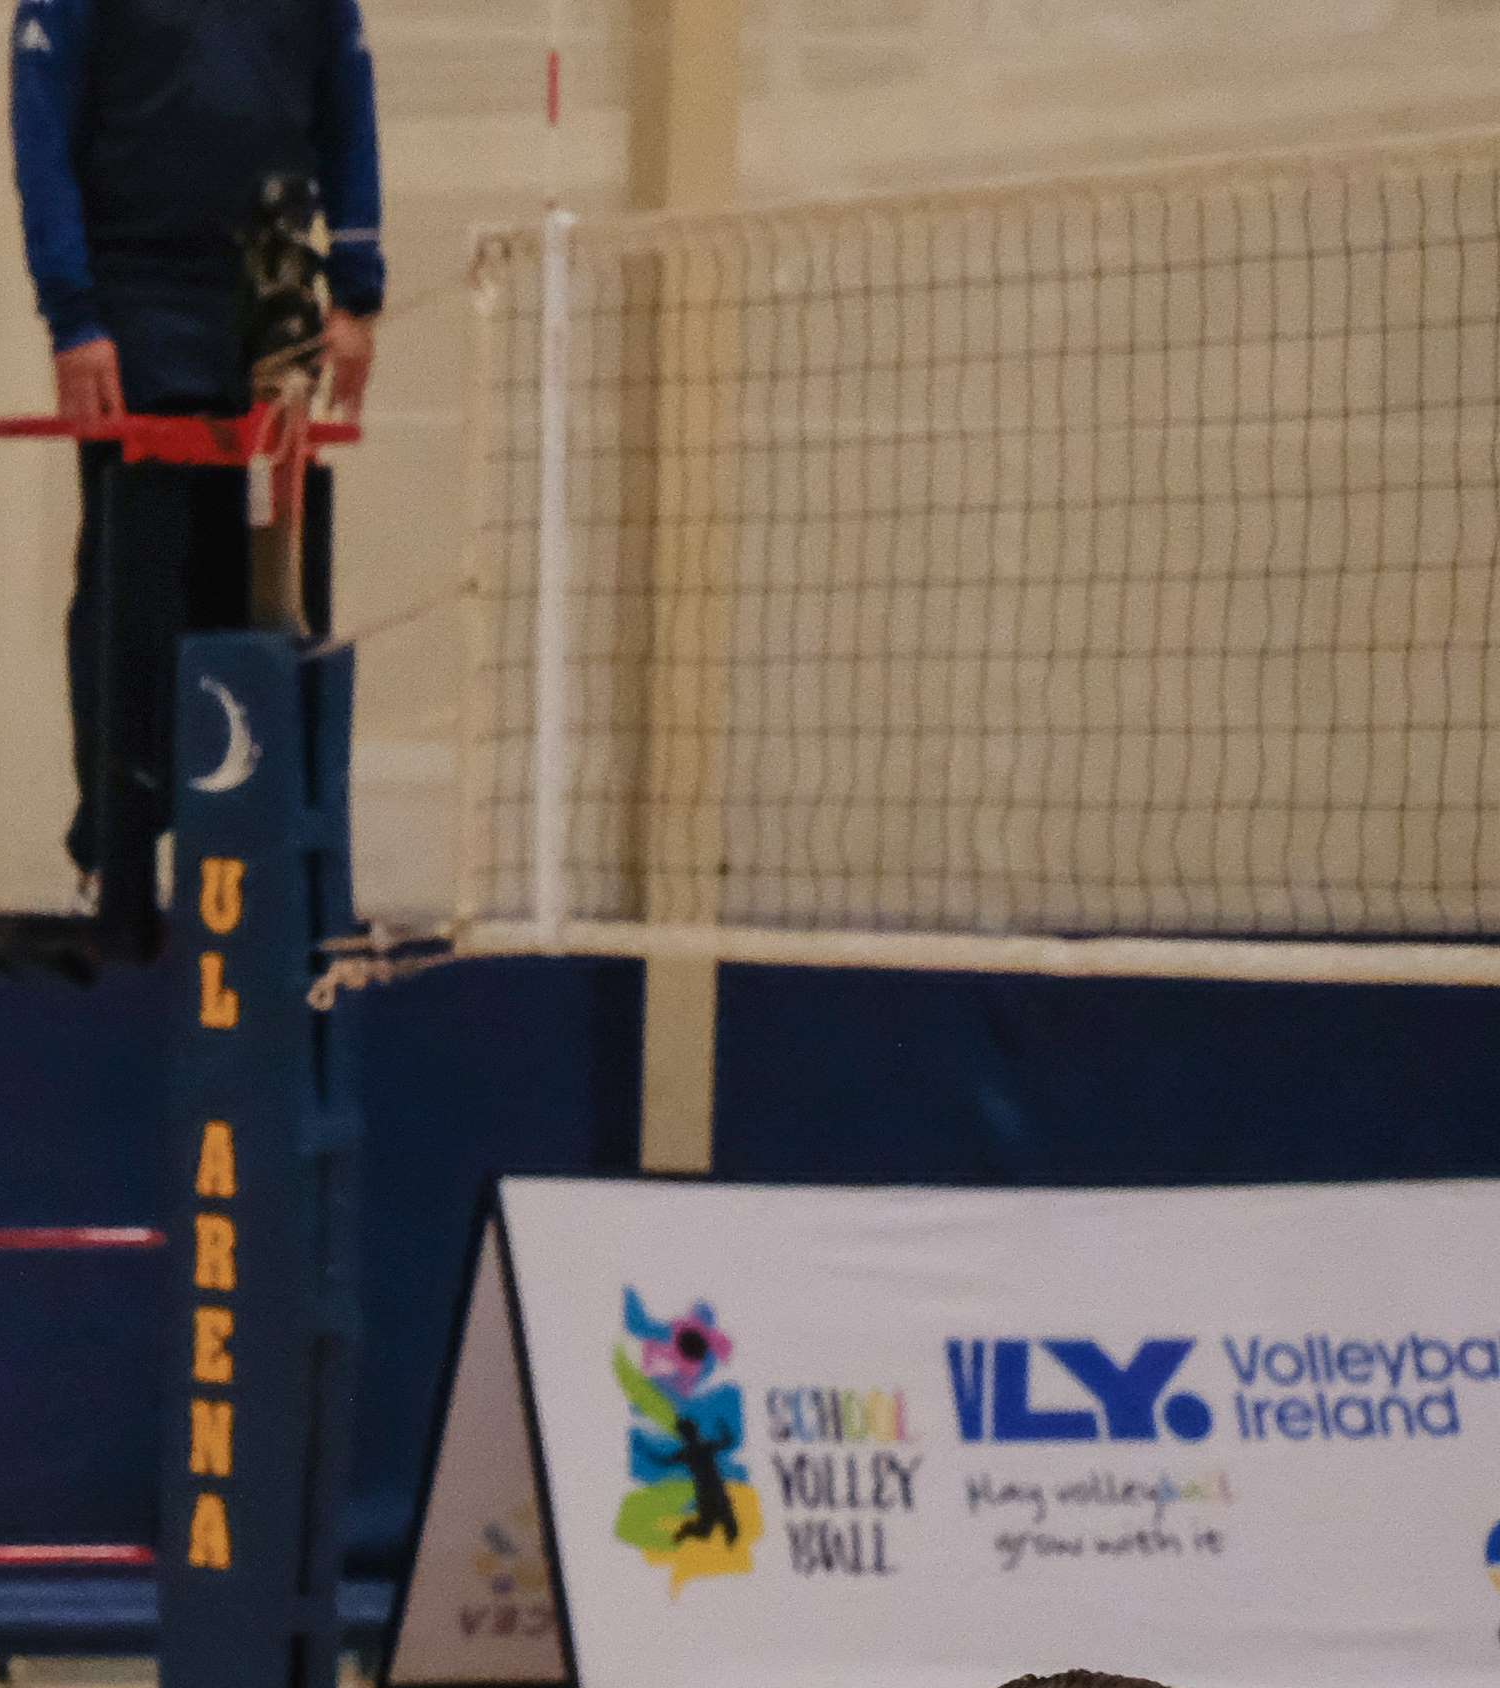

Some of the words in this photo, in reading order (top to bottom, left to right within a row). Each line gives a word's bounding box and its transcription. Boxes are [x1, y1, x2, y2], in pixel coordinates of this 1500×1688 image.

[188, 1119, 238, 1572] ARENA
[1221, 1331, 1500, 1386] Volleyba
[766, 1385, 923, 1440] SCHOOL
[1233, 1388, 1463, 1441] Ireland
[770, 1451, 924, 1510] VOLLEY
[786, 1519, 896, 1577] BALL
